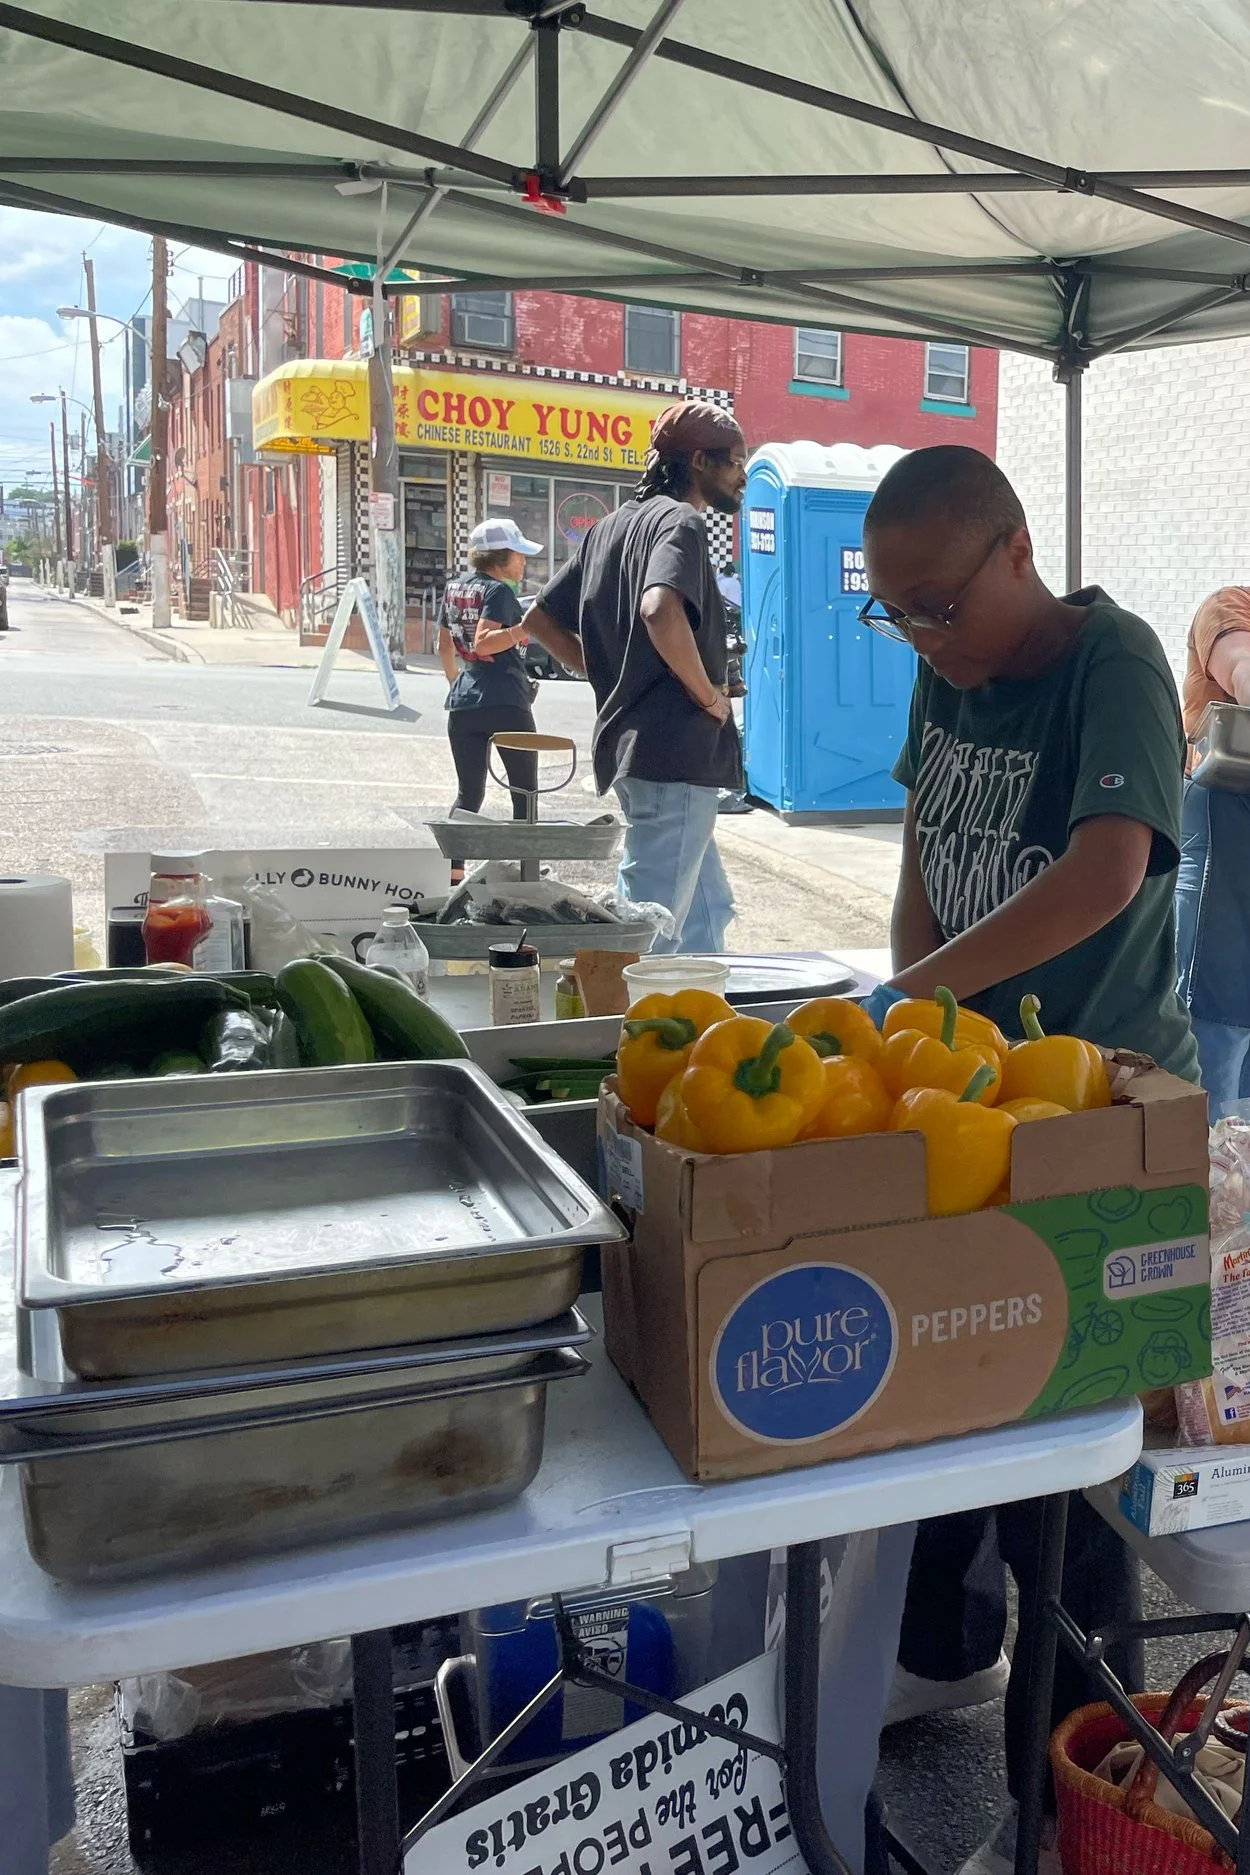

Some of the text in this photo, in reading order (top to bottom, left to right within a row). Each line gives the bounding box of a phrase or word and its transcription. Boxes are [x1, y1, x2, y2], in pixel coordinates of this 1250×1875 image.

[417, 389, 515, 431] CHOY
[532, 403, 632, 446] YUNG
[417, 424, 460, 444] CHINESE
[465, 431, 531, 453] RESTAURANT
[539, 441, 560, 457] 1526
[577, 443, 599, 461] 22nd
[603, 448, 613, 462] St
[319, 872, 381, 893] BUNNY
[1141, 1244, 1196, 1267] GREENHOUSE
[1141, 1263, 1173, 1282] GROWN
[1223, 1271, 1240, 1283] The
[762, 1303, 870, 1360] pure
[911, 1293, 1043, 1347] PEPPERS
[1177, 1481, 1195, 1496] 365
[579, 1607, 629, 1625] WARNING
[579, 1624, 609, 1638] AVISO
[705, 1745, 749, 1800] for
[655, 1780, 697, 1830] the
[465, 1772, 602, 1870] Gratis
